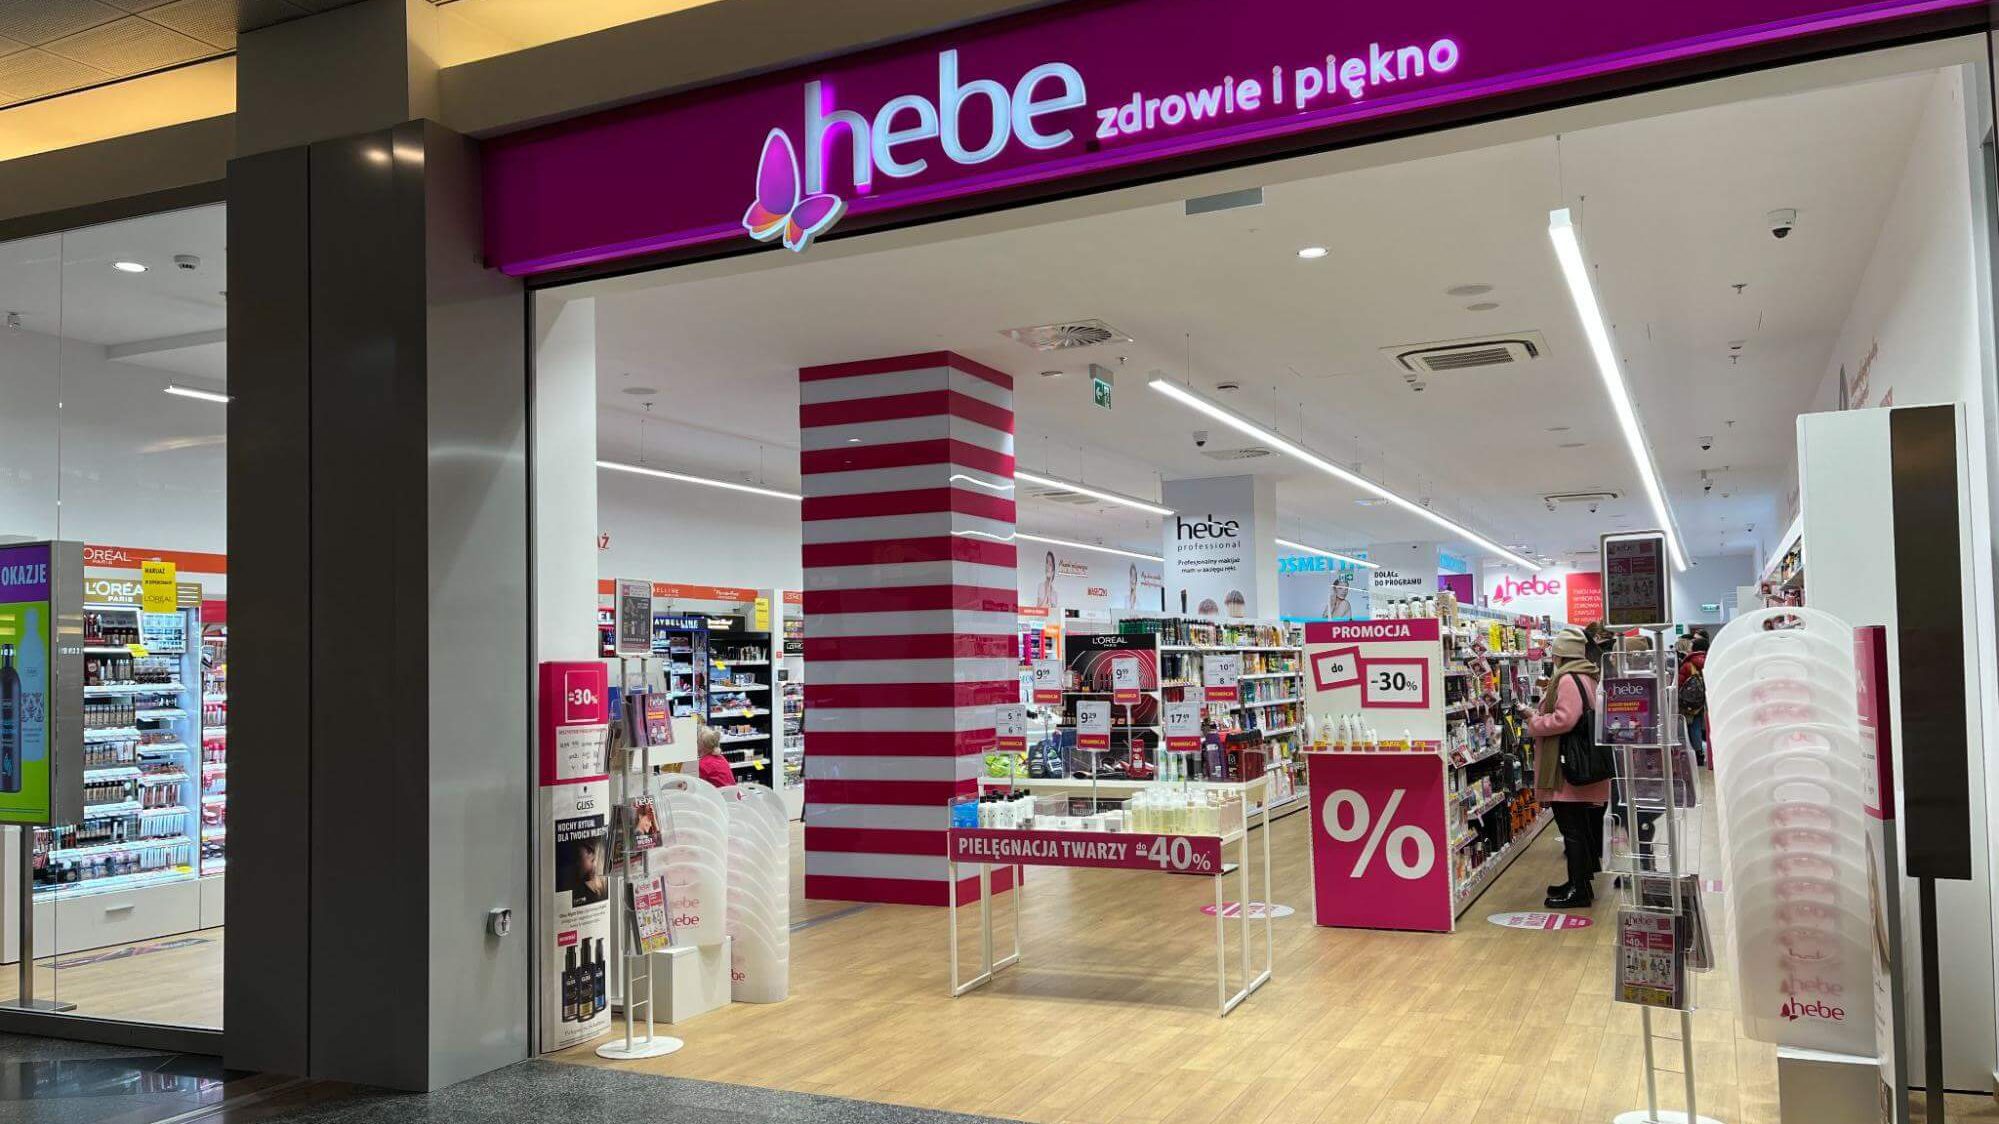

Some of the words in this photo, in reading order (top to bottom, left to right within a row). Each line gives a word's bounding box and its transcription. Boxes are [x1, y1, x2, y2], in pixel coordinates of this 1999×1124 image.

[1096, 75, 1260, 139] zdrowie
[1272, 66, 1283, 104] i
[1295, 38, 1459, 109] piękno
[805, 49, 1087, 195] hebe
[1177, 514, 1240, 540] hebe
[1177, 540, 1240, 552] professional
[83, 547, 132, 561] ORÉAL
[2, 564, 47, 586] OKAZJE
[1385, 578, 1421, 586] PROGRAMU
[85, 581, 143, 596] L'ORÉA
[1505, 575, 1561, 596] hebe
[655, 618, 698, 628] AYBELLINE
[1332, 625, 1411, 638] PROMOCJA
[1331, 663, 1343, 673] do
[1371, 672, 1418, 691] -30%
[1613, 683, 1644, 695] hebe
[576, 799, 595, 811] GLISS
[557, 832, 569, 843] DLA
[958, 837, 1058, 860] PIELĘGNACJA
[1061, 841, 1127, 861] TWARZY
[1136, 842, 1147, 851] do
[673, 913, 700, 928] ebe
[731, 968, 746, 981] be
[1790, 997, 1845, 1021] hebe
